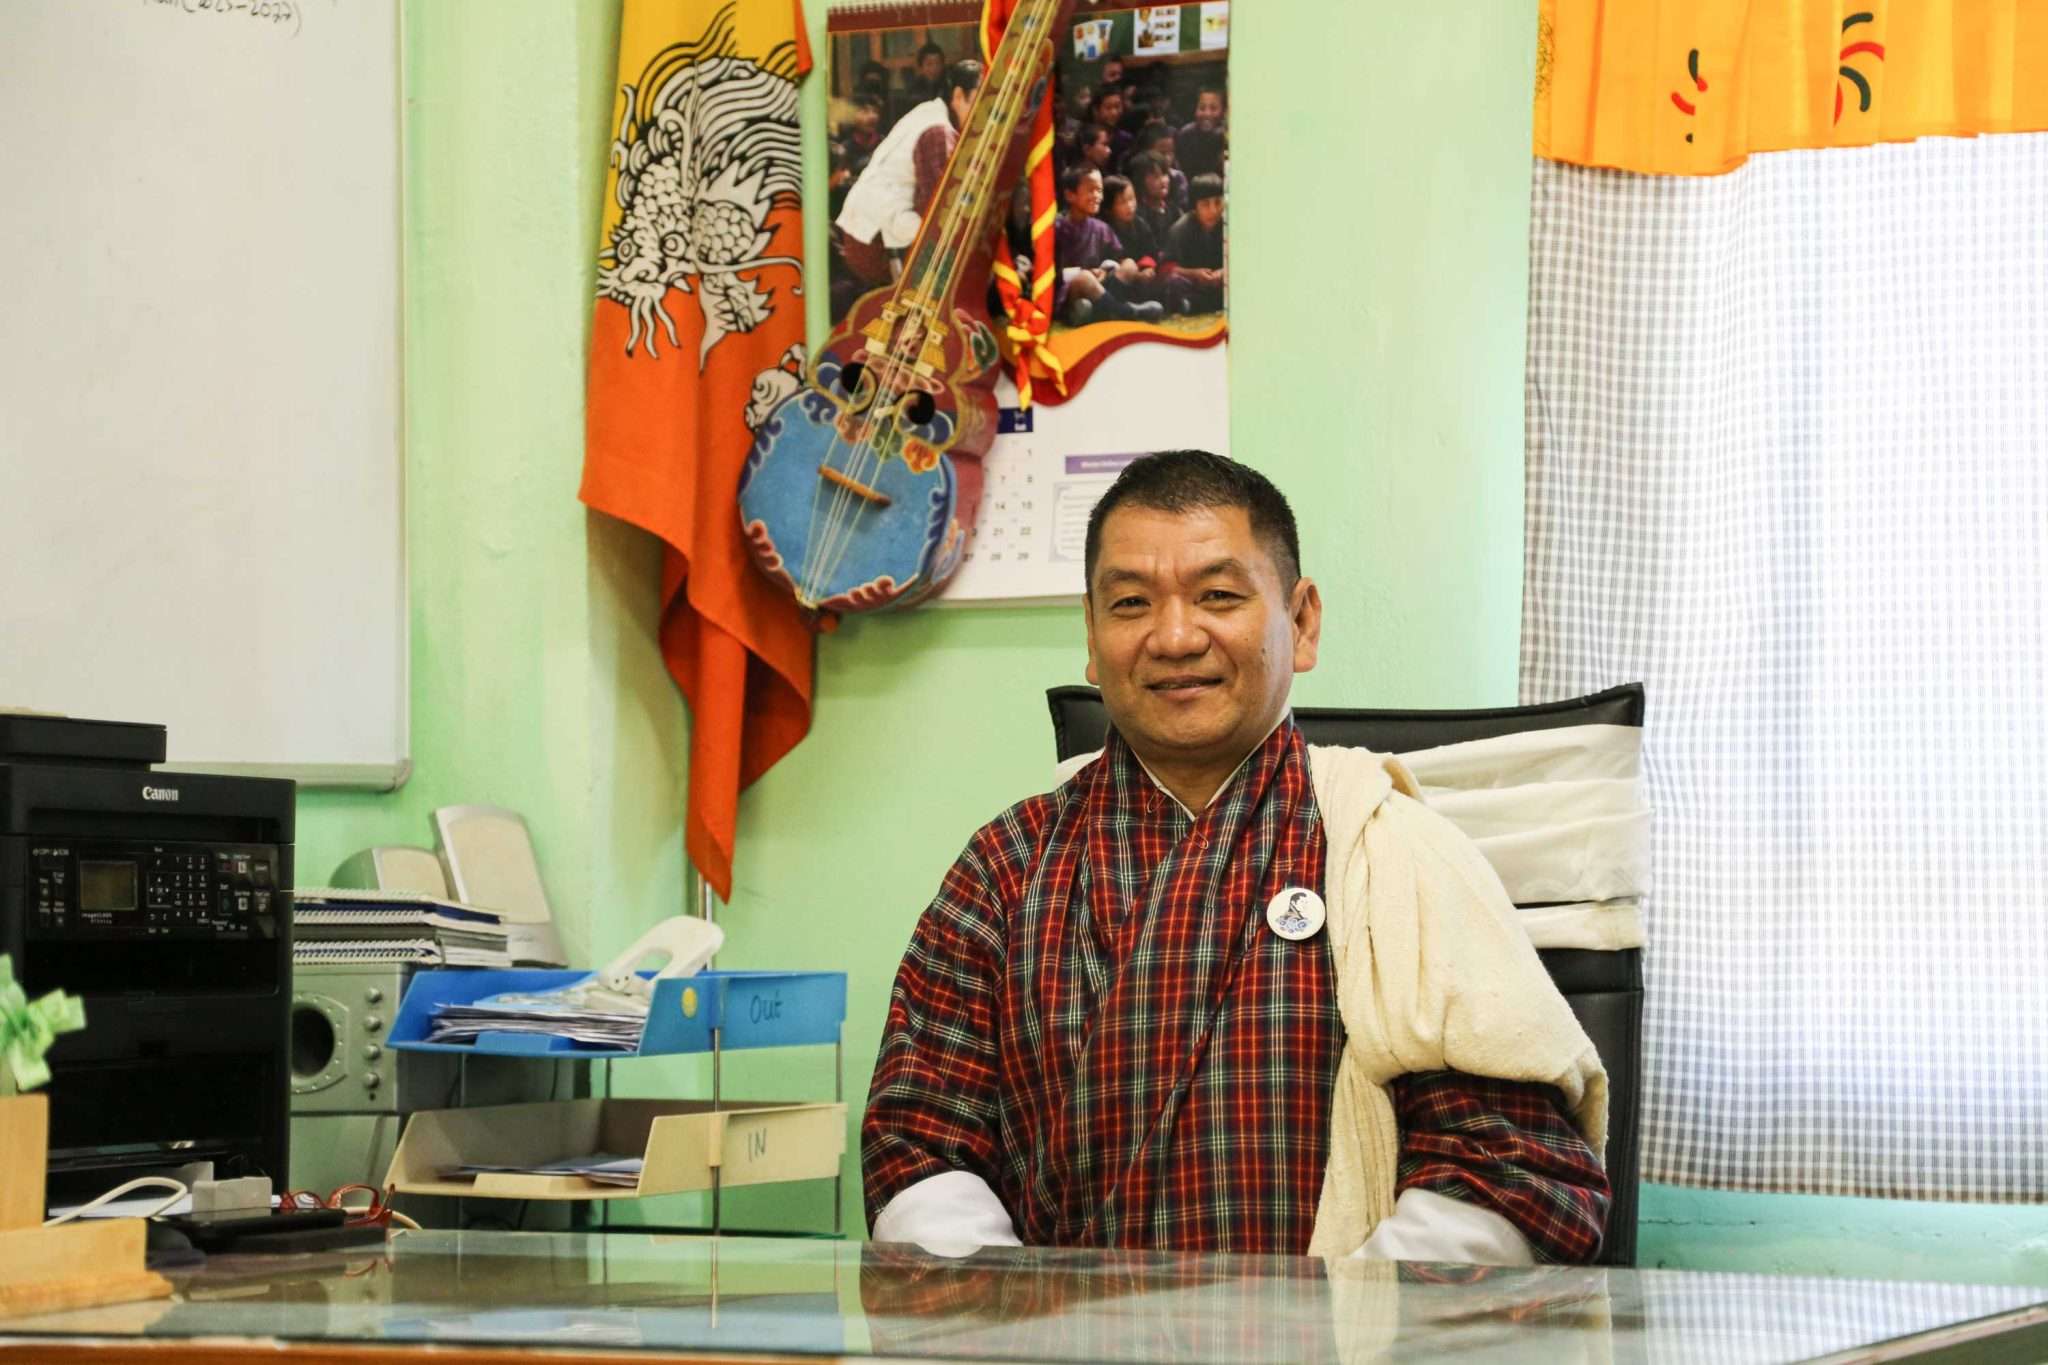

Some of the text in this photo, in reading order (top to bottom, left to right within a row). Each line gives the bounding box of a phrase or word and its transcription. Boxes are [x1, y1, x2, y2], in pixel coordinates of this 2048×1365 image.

[142, 785, 180, 801] Canon
[749, 988, 783, 1025] Out
[747, 1127, 767, 1163] IN
